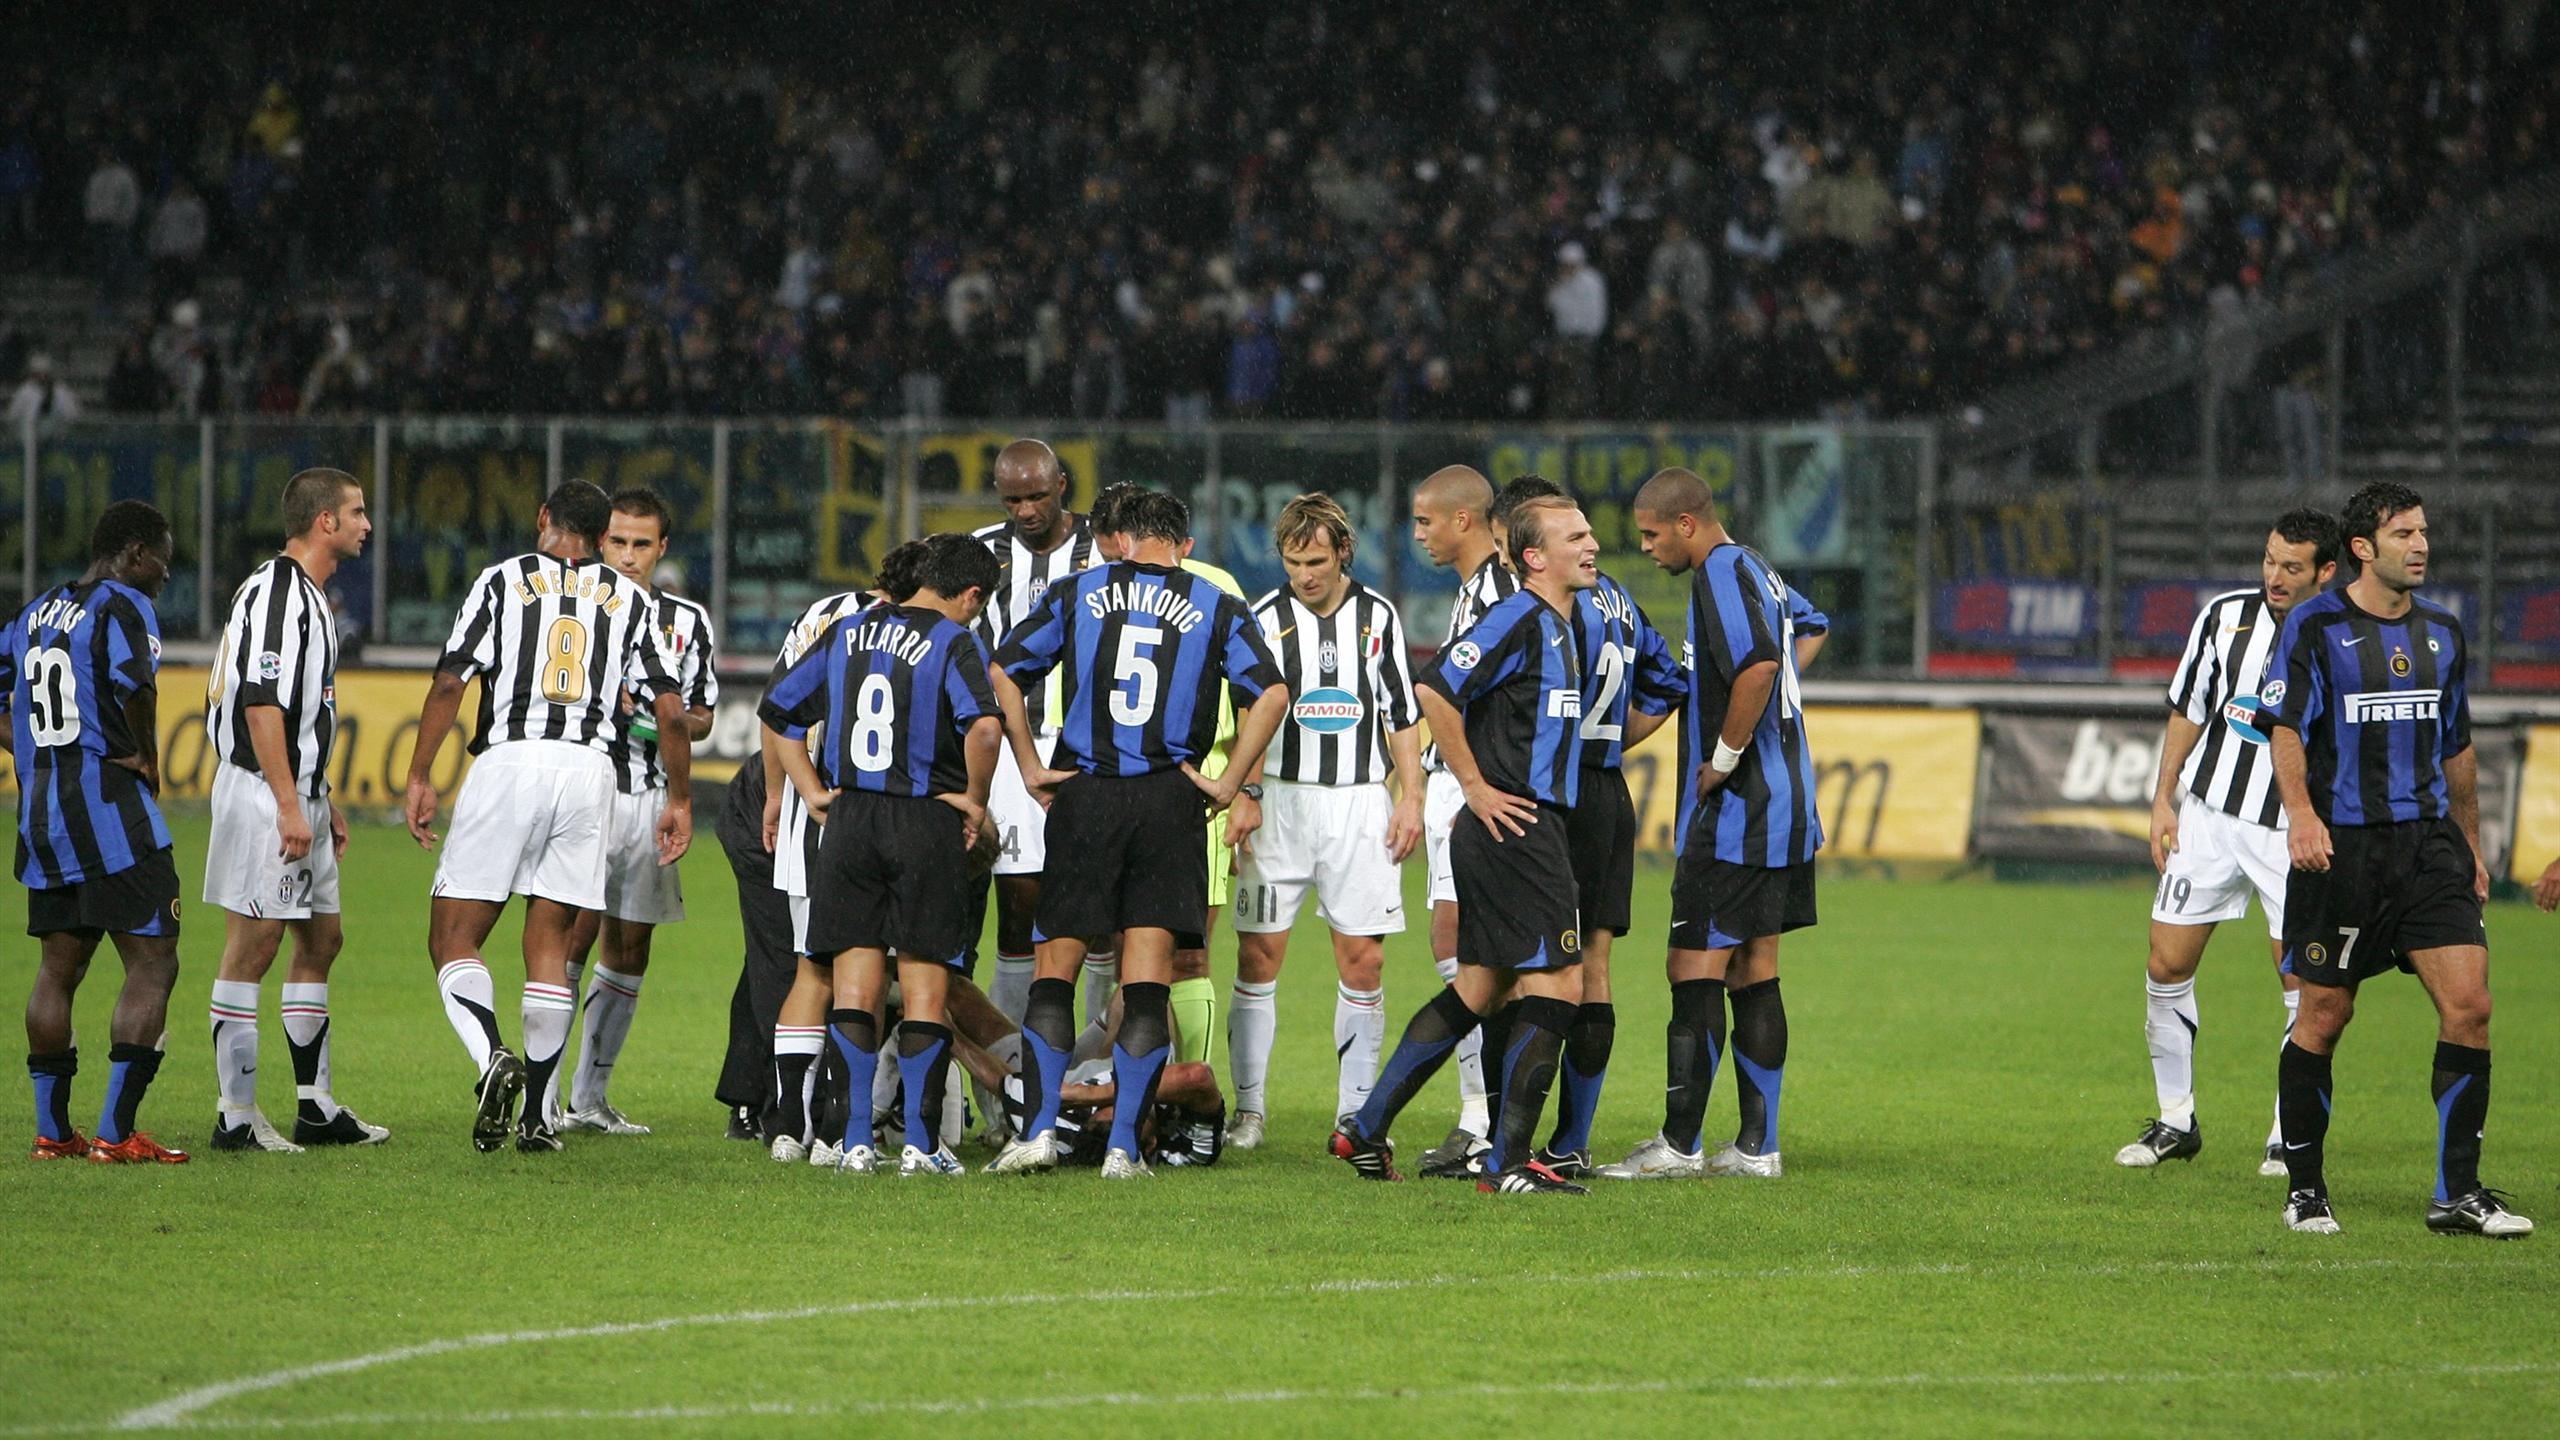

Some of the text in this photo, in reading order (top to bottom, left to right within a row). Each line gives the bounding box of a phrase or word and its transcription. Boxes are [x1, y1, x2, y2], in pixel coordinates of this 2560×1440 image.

[513, 568, 624, 617] EMERSON
[1085, 582, 1204, 634] STANKOVIC
[2008, 584, 2084, 637] TIM
[541, 616, 587, 705] 8
[845, 621, 932, 666] PIZARRO
[24, 646, 81, 748] 30
[1108, 624, 1163, 726] 5
[850, 673, 895, 772] 8
[1295, 704, 1361, 717] TAMOIL
[1001, 825, 1021, 862] 4
[1257, 885, 1277, 923] 11
[2160, 873, 2192, 915] 19
[2338, 926, 2360, 970] 7
